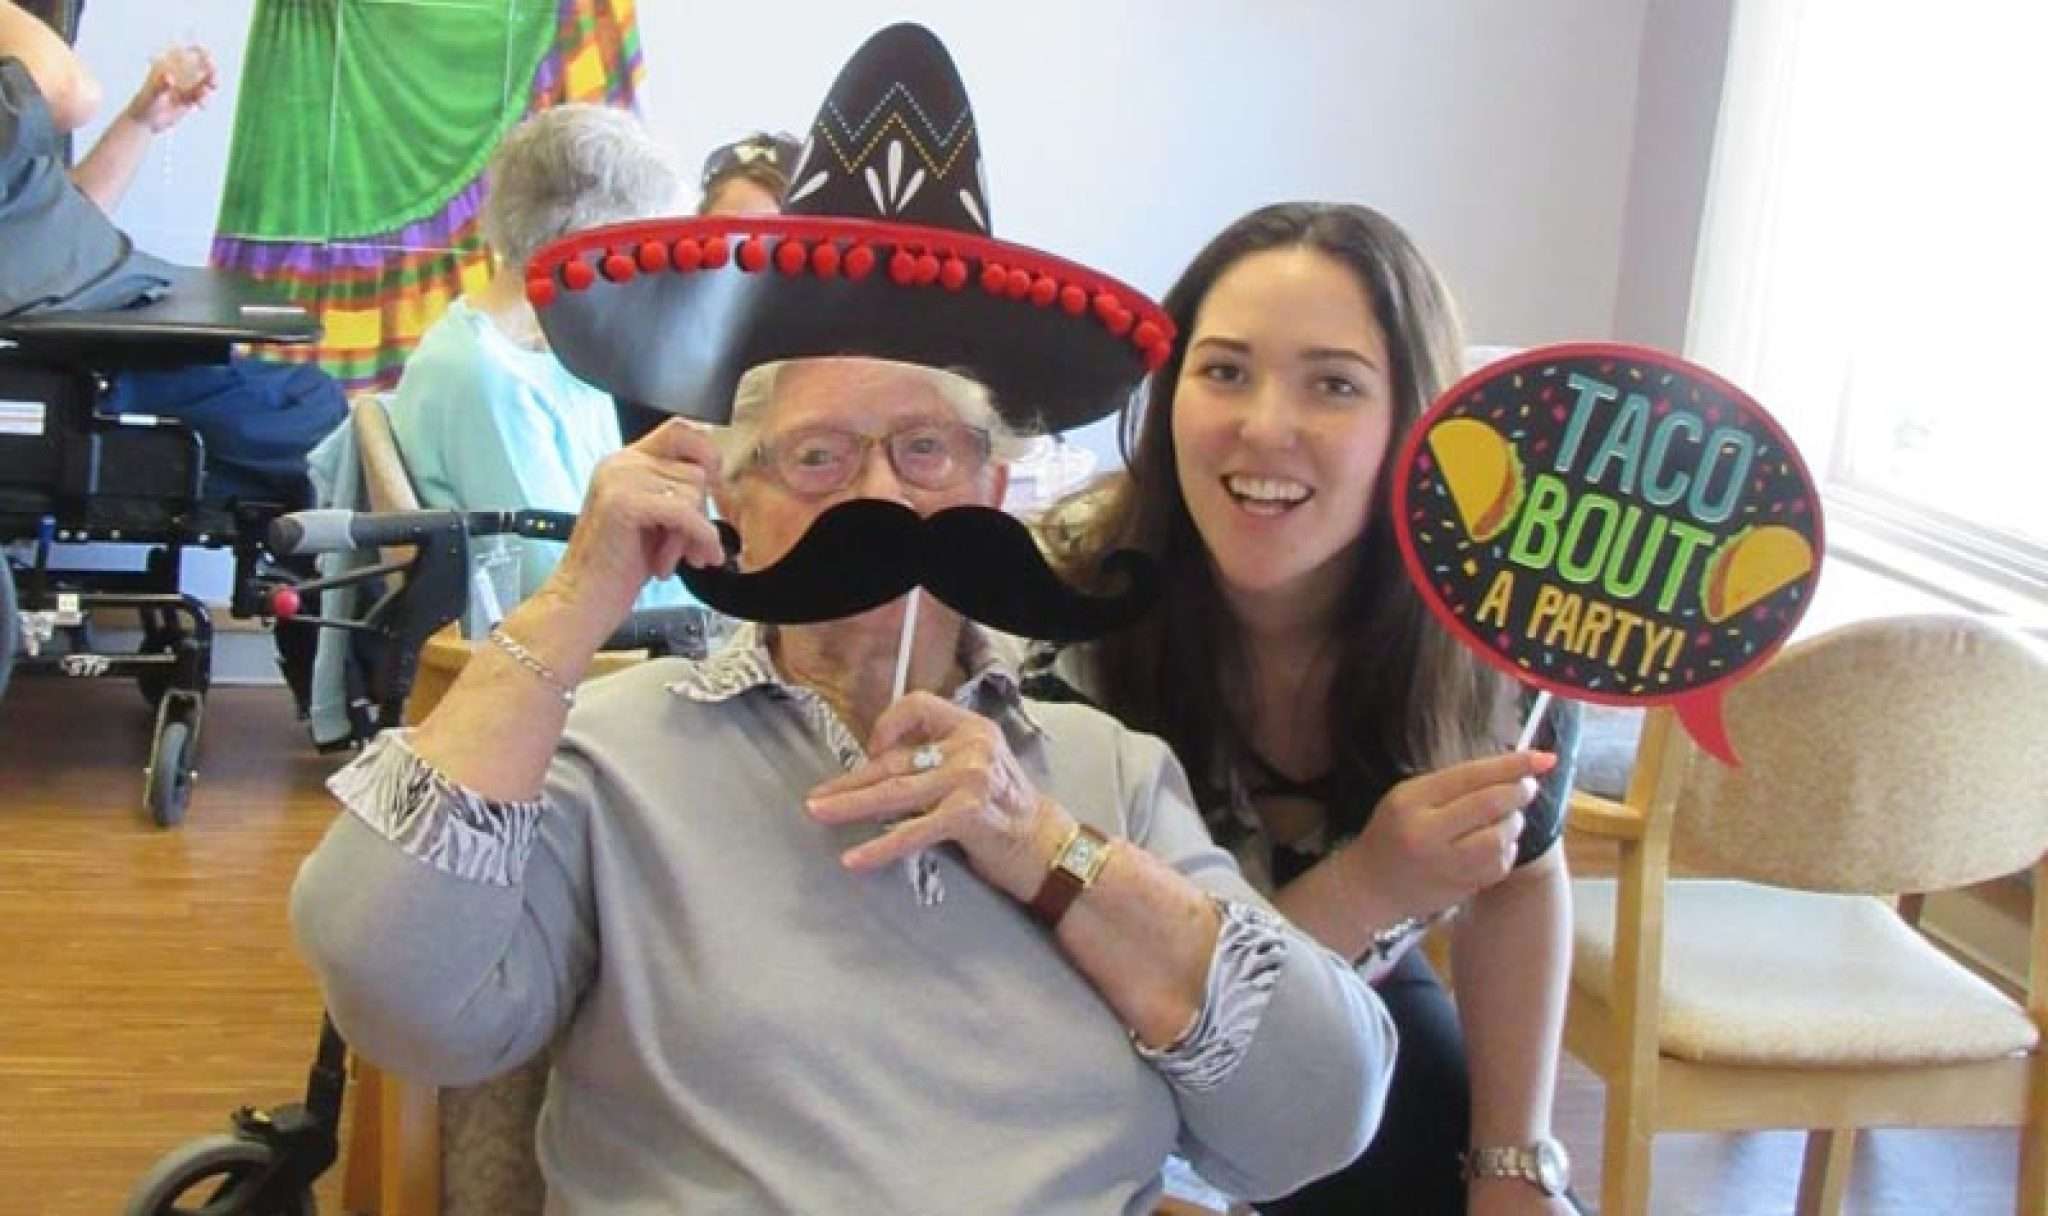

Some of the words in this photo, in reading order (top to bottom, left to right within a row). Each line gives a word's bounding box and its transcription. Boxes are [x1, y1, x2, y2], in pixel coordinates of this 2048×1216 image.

[1555, 373, 1754, 523] TACO
[1509, 475, 1714, 612] BOUT
[1475, 570, 1514, 628] A
[1527, 584, 1686, 683] PARTY!
